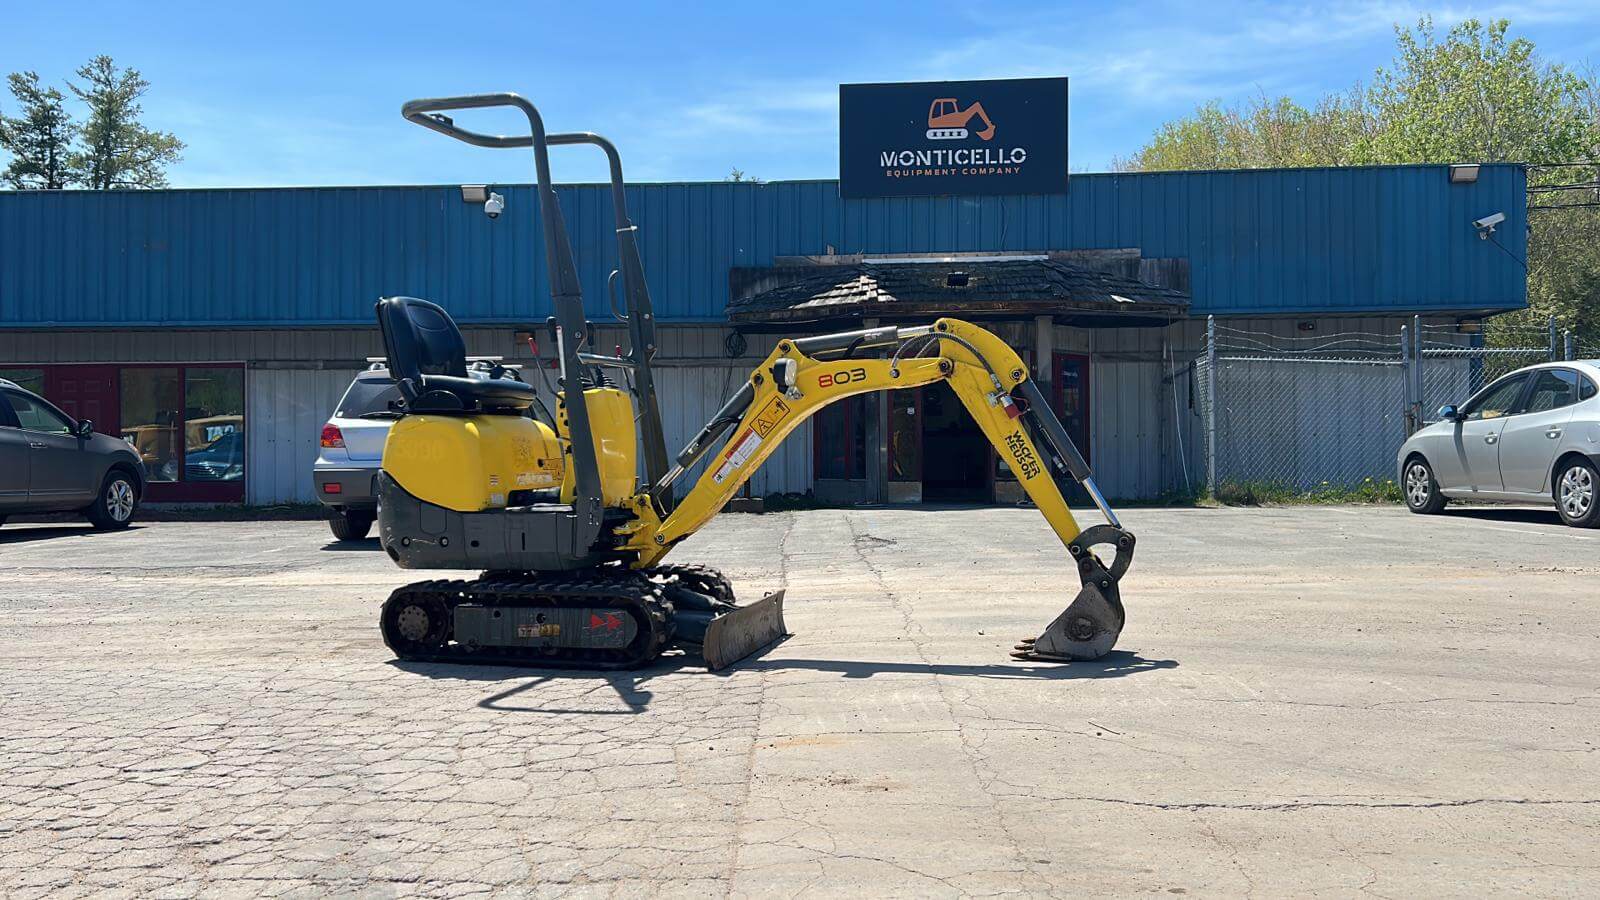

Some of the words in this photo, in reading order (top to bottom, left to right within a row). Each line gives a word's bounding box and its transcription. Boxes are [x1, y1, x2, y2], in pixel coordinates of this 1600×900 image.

[880, 148, 1027, 167] MONTICELLO
[886, 168, 957, 178] EQUIPMENT
[961, 166, 1021, 176] COMPANY
[819, 368, 867, 388] 803
[1005, 435, 1034, 480] NEUSON
[1013, 430, 1040, 477] WACKER
